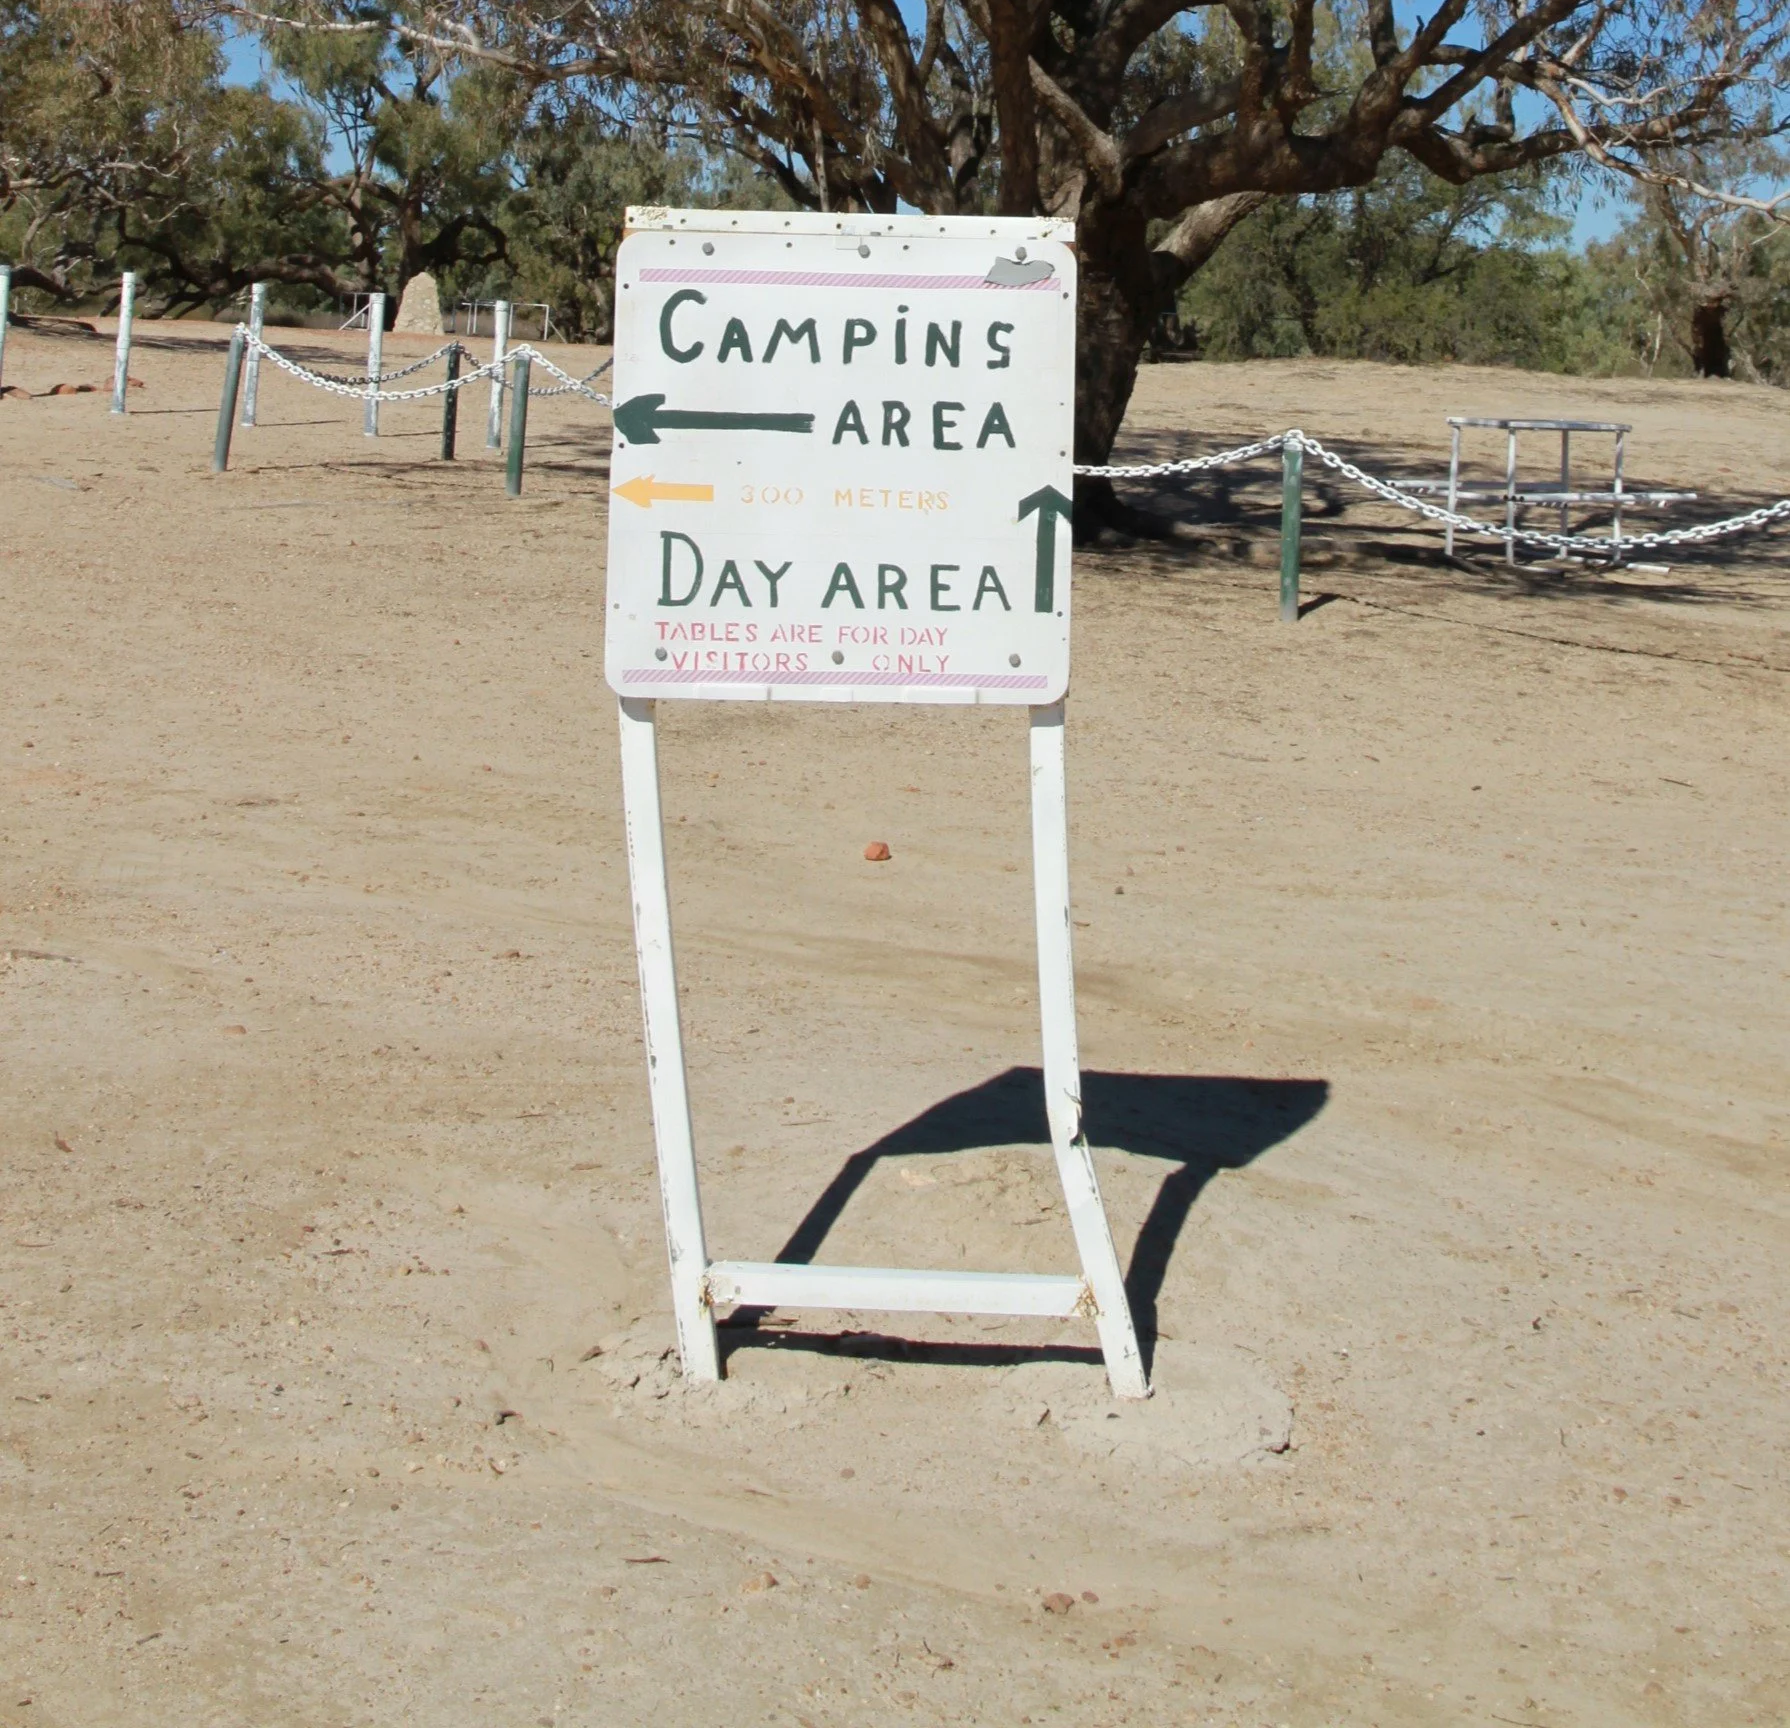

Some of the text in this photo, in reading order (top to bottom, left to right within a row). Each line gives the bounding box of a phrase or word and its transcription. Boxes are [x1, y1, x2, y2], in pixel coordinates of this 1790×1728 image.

[831, 399, 1017, 451] AREA
[740, 484, 950, 511] 300 METERS
[657, 530, 1012, 612] DAY AREA
[655, 621, 948, 646] TABLES ARE FOR DAY
[671, 650, 950, 674] VISITORS ONLY
